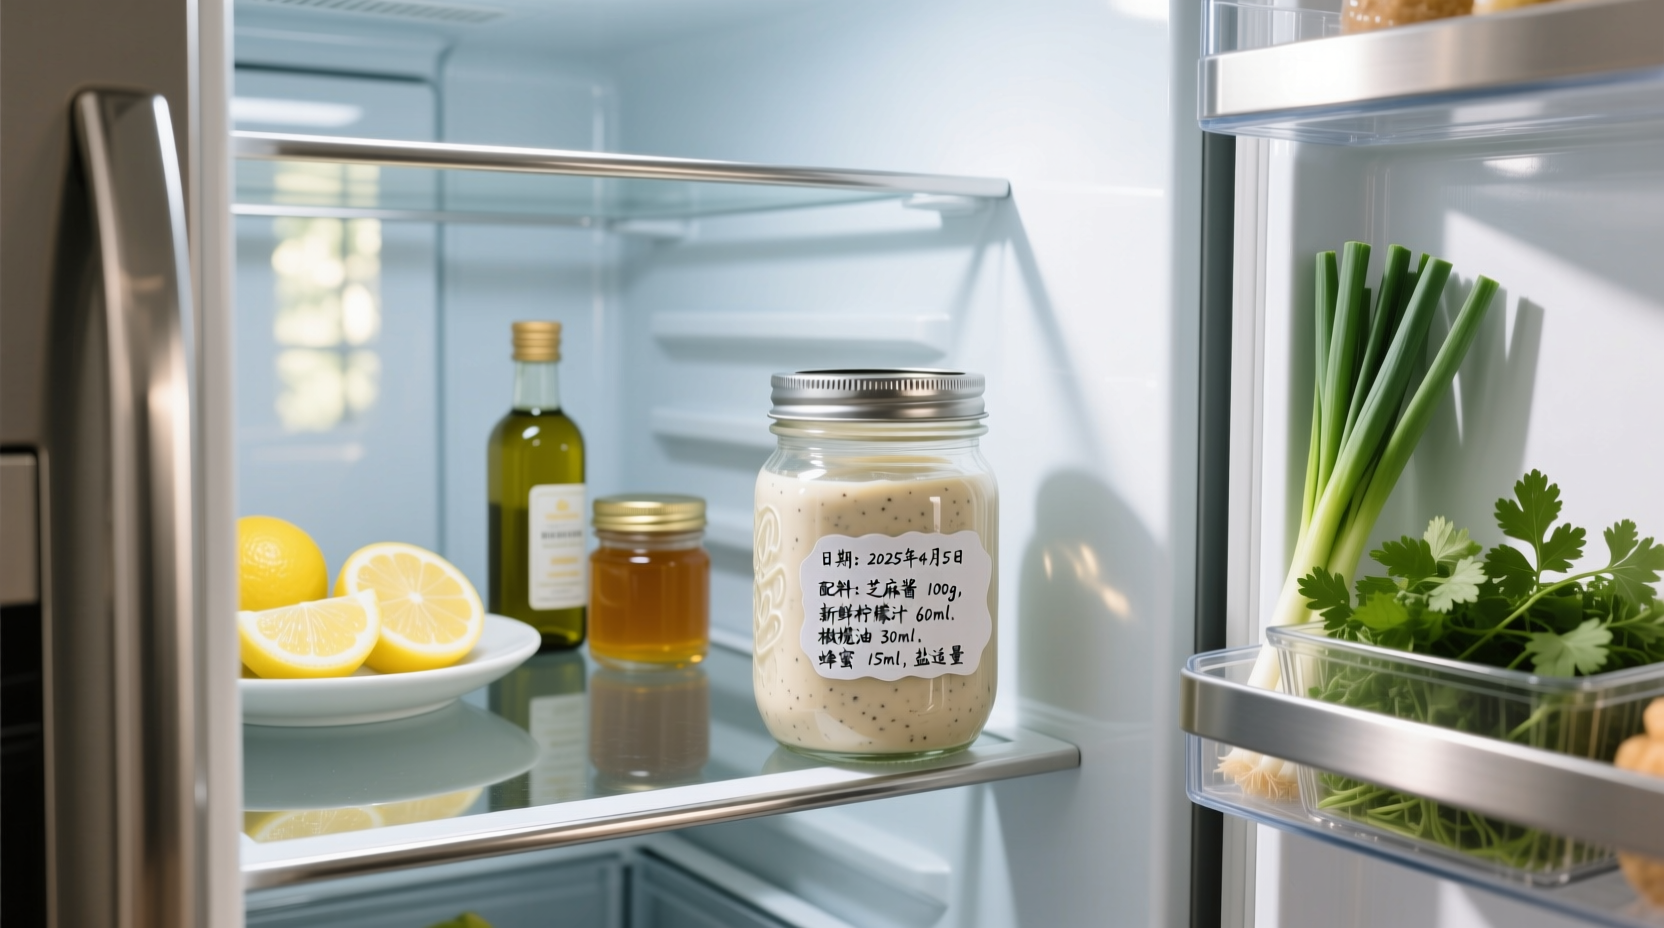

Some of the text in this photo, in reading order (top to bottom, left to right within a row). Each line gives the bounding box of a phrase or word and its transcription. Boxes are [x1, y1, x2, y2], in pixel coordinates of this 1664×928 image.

[867, 548, 962, 568] 2025年4月5日
[866, 578, 917, 599] 芝麻酱
